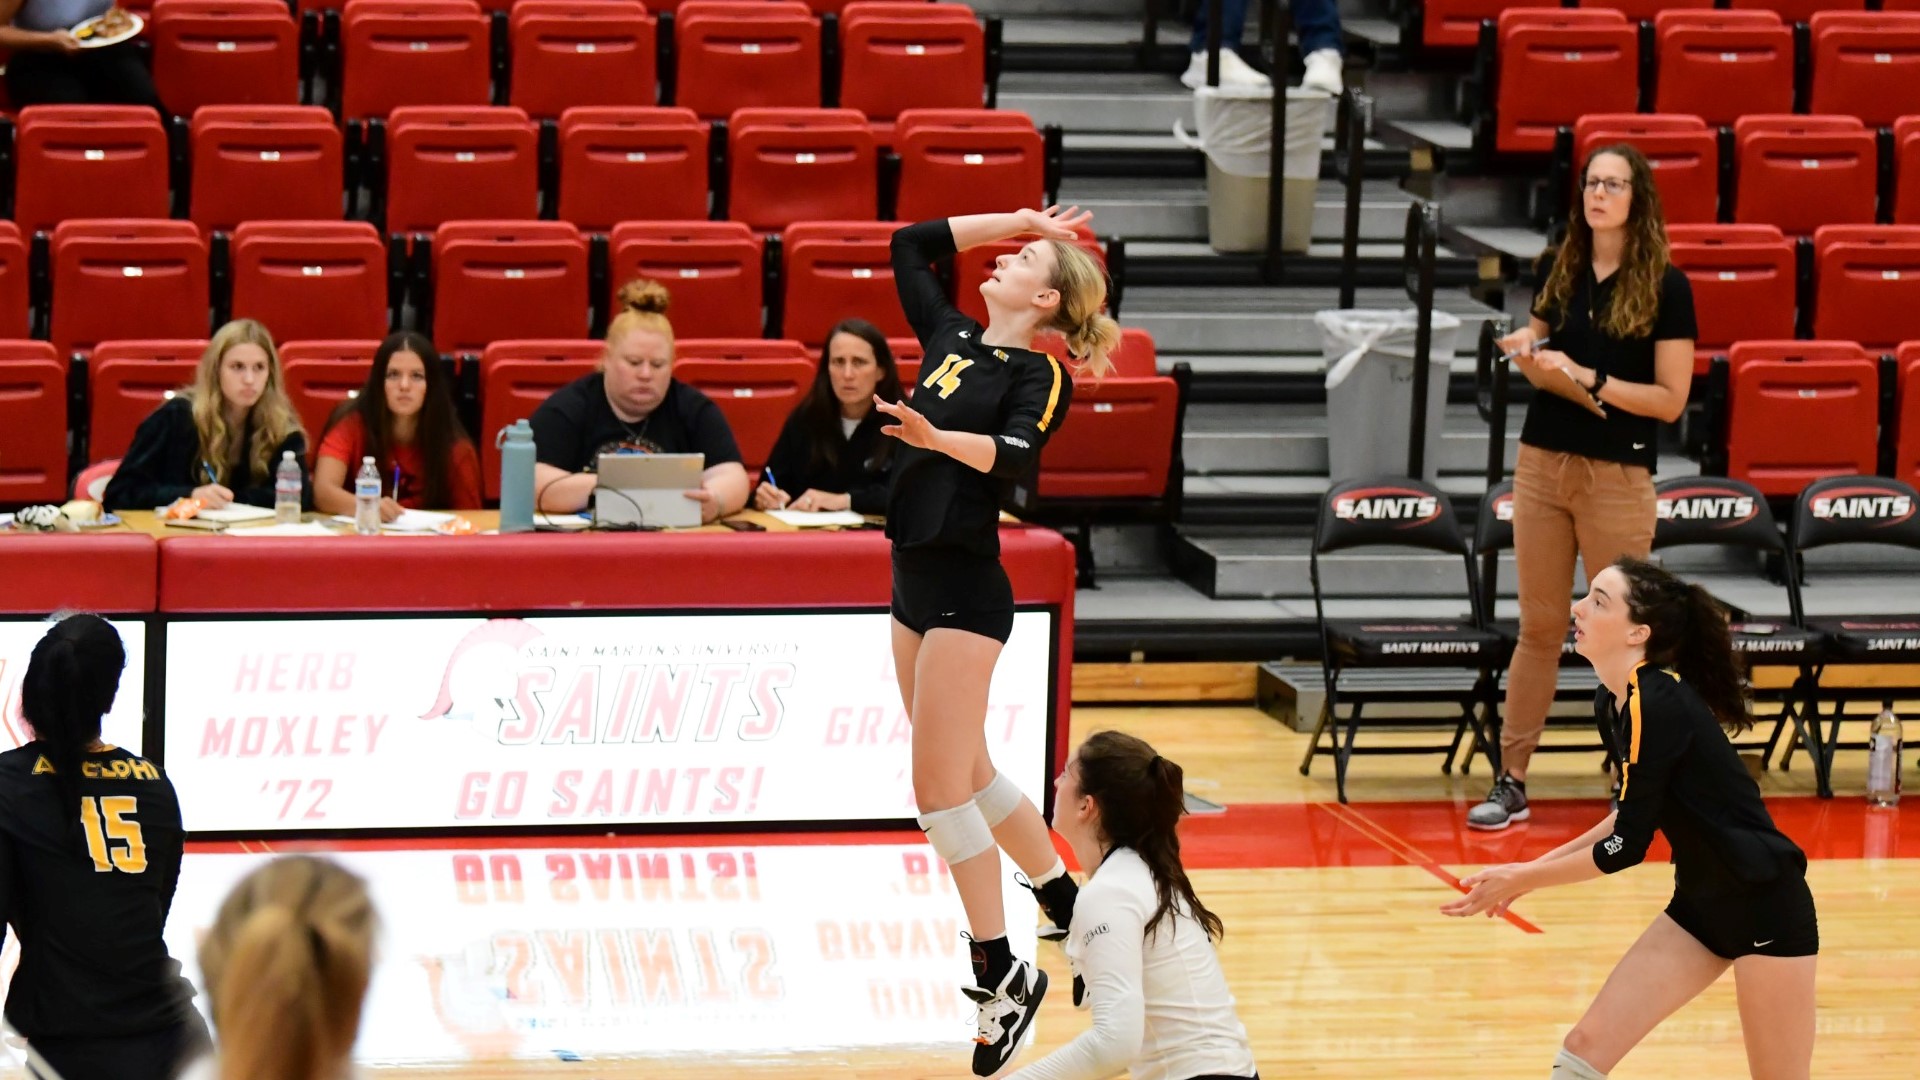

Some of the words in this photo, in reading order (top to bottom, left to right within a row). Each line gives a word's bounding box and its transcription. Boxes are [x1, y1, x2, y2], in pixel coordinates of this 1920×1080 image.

[922, 353, 975, 400] 14
[1335, 496, 1437, 520] SAINTS
[1656, 496, 1754, 519] SAINTS
[1813, 495, 1911, 518] SAINTS
[592, 644, 684, 657] MARTINS
[1381, 641, 1421, 654] SAINT
[1867, 638, 1906, 651] SAINT
[233, 651, 357, 693] HERB
[497, 662, 797, 745] SAINTS
[198, 714, 389, 758] MOXLEY
[32, 753, 161, 781] AELPHI
[258, 778, 334, 820] '72
[453, 770, 529, 820] GO
[546, 766, 766, 818] SAINTS!
[80, 795, 148, 874] 15
